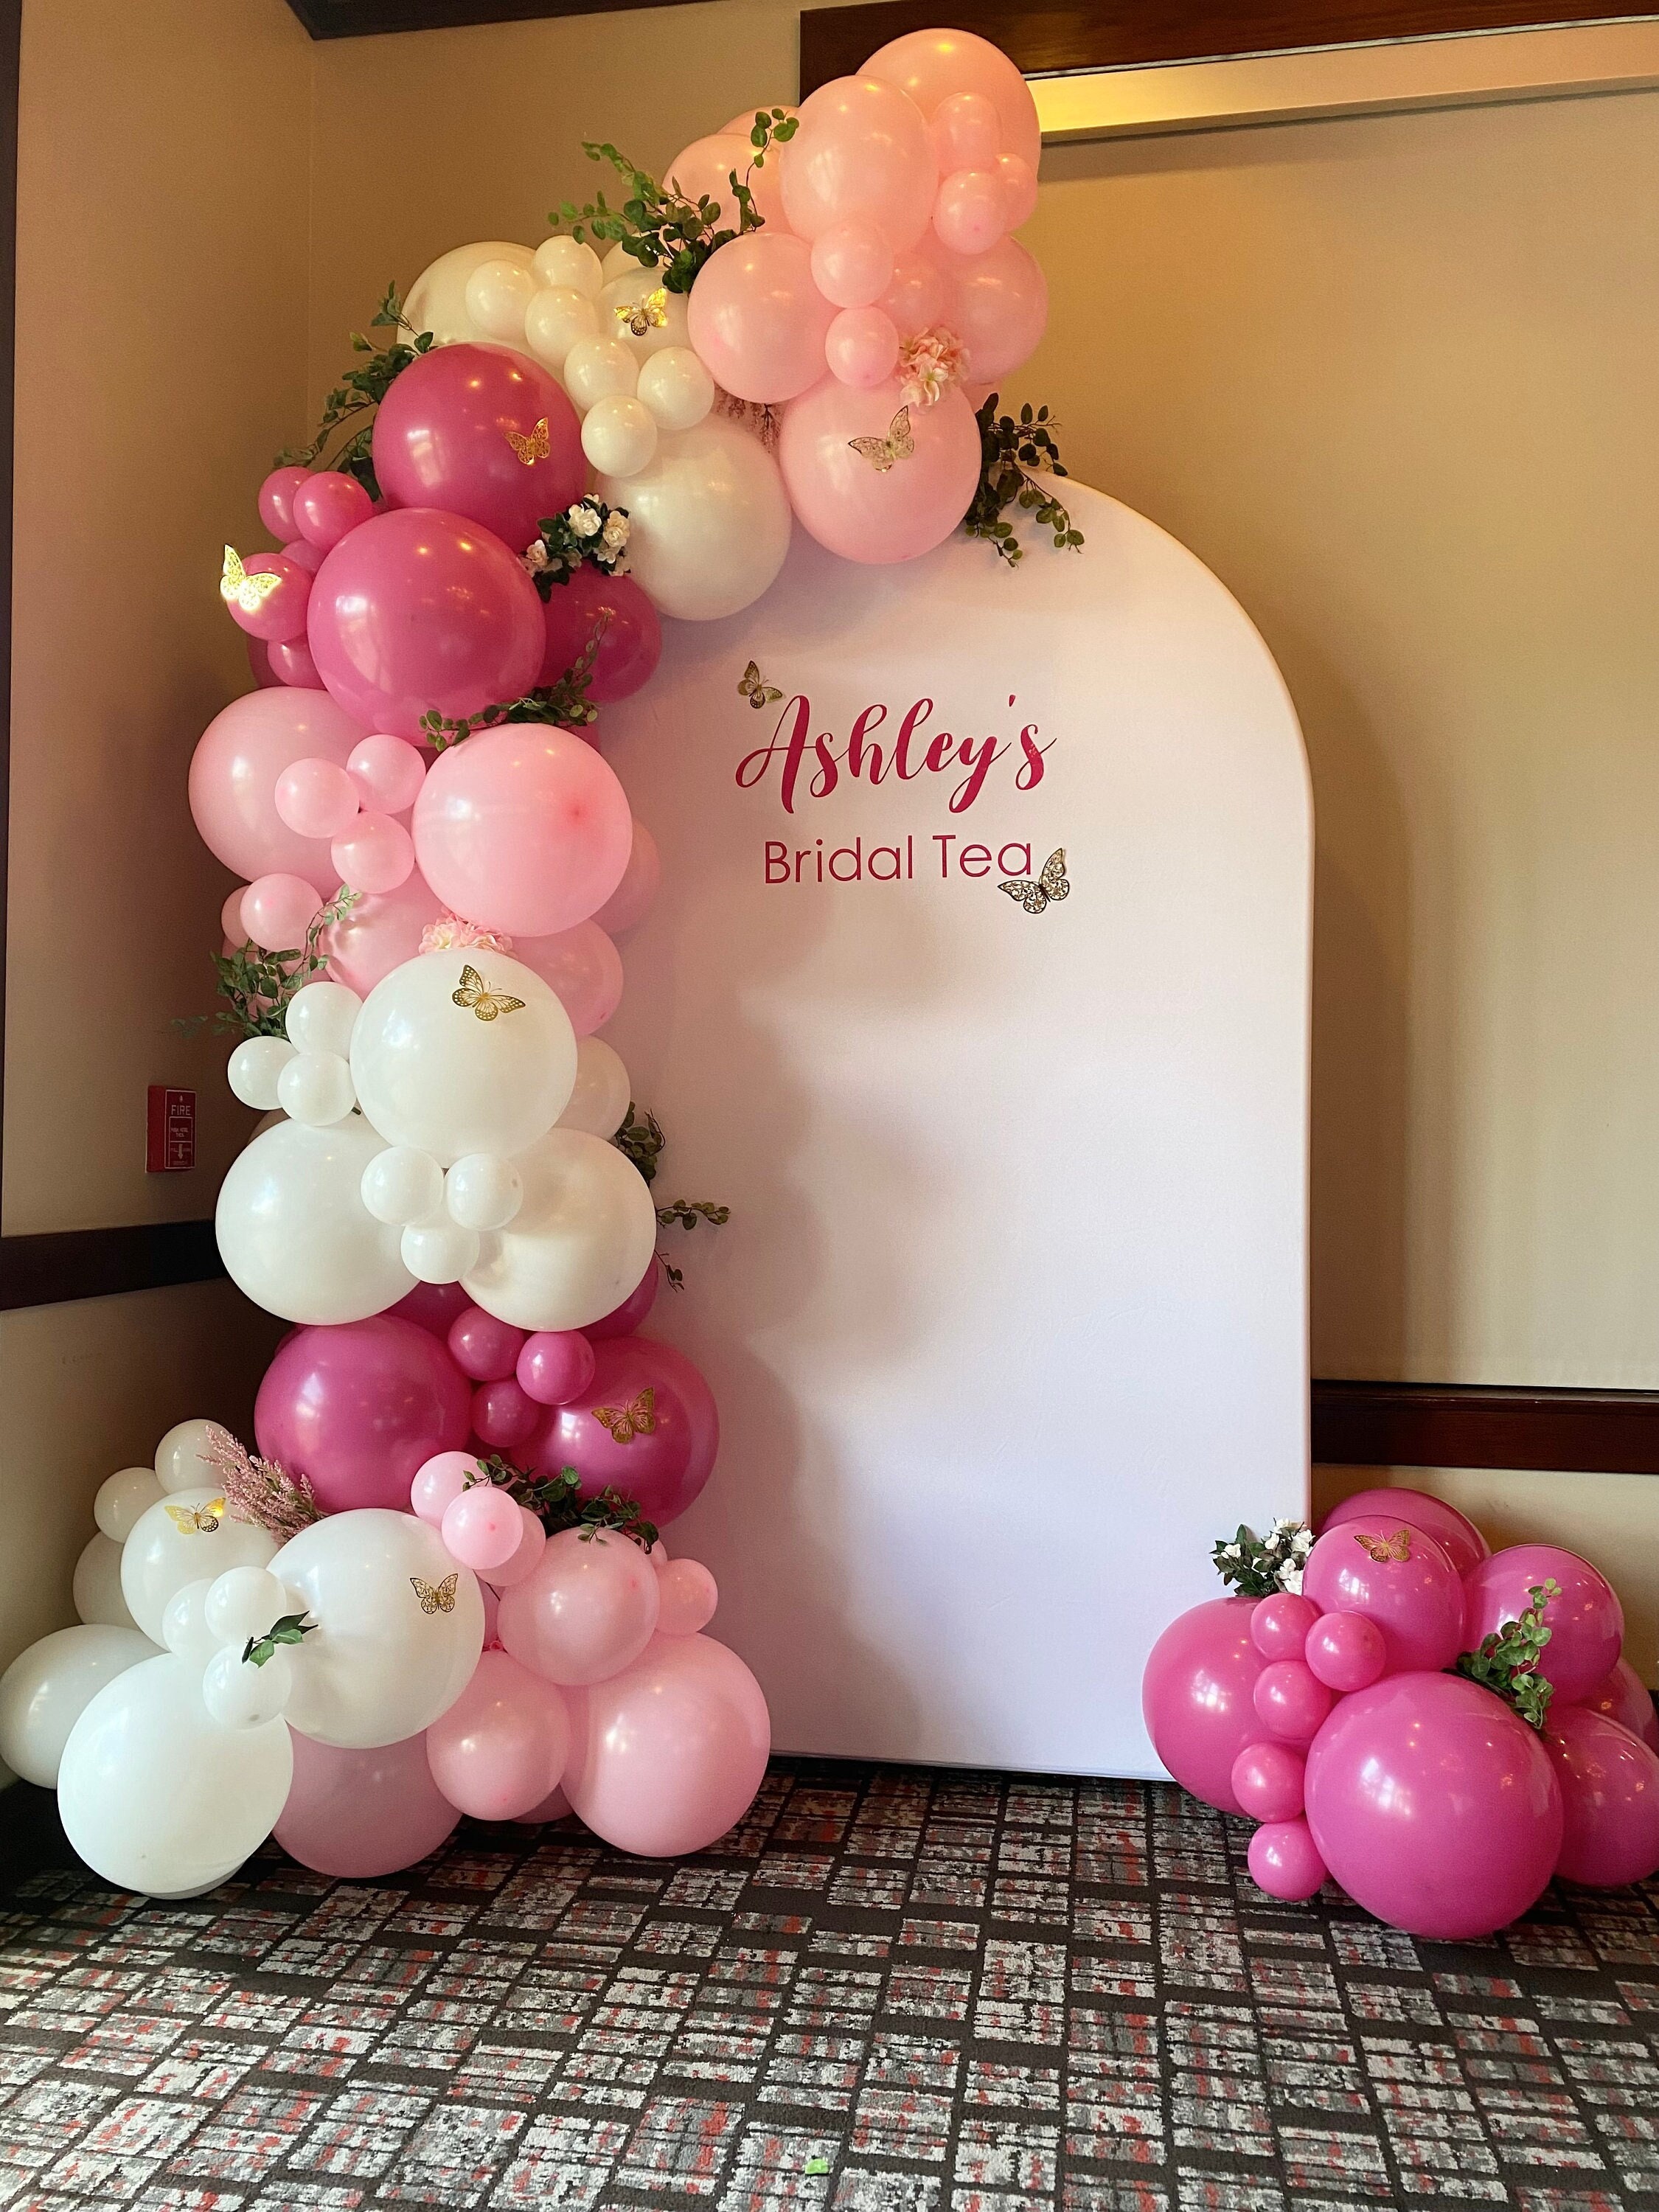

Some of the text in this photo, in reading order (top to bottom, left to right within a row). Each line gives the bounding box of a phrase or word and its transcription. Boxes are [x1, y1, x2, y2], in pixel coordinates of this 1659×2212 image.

[736, 695, 1057, 814] Ashley's
[765, 834, 1032, 884] Bridal Tea
[171, 1105, 191, 1116] FIRE
